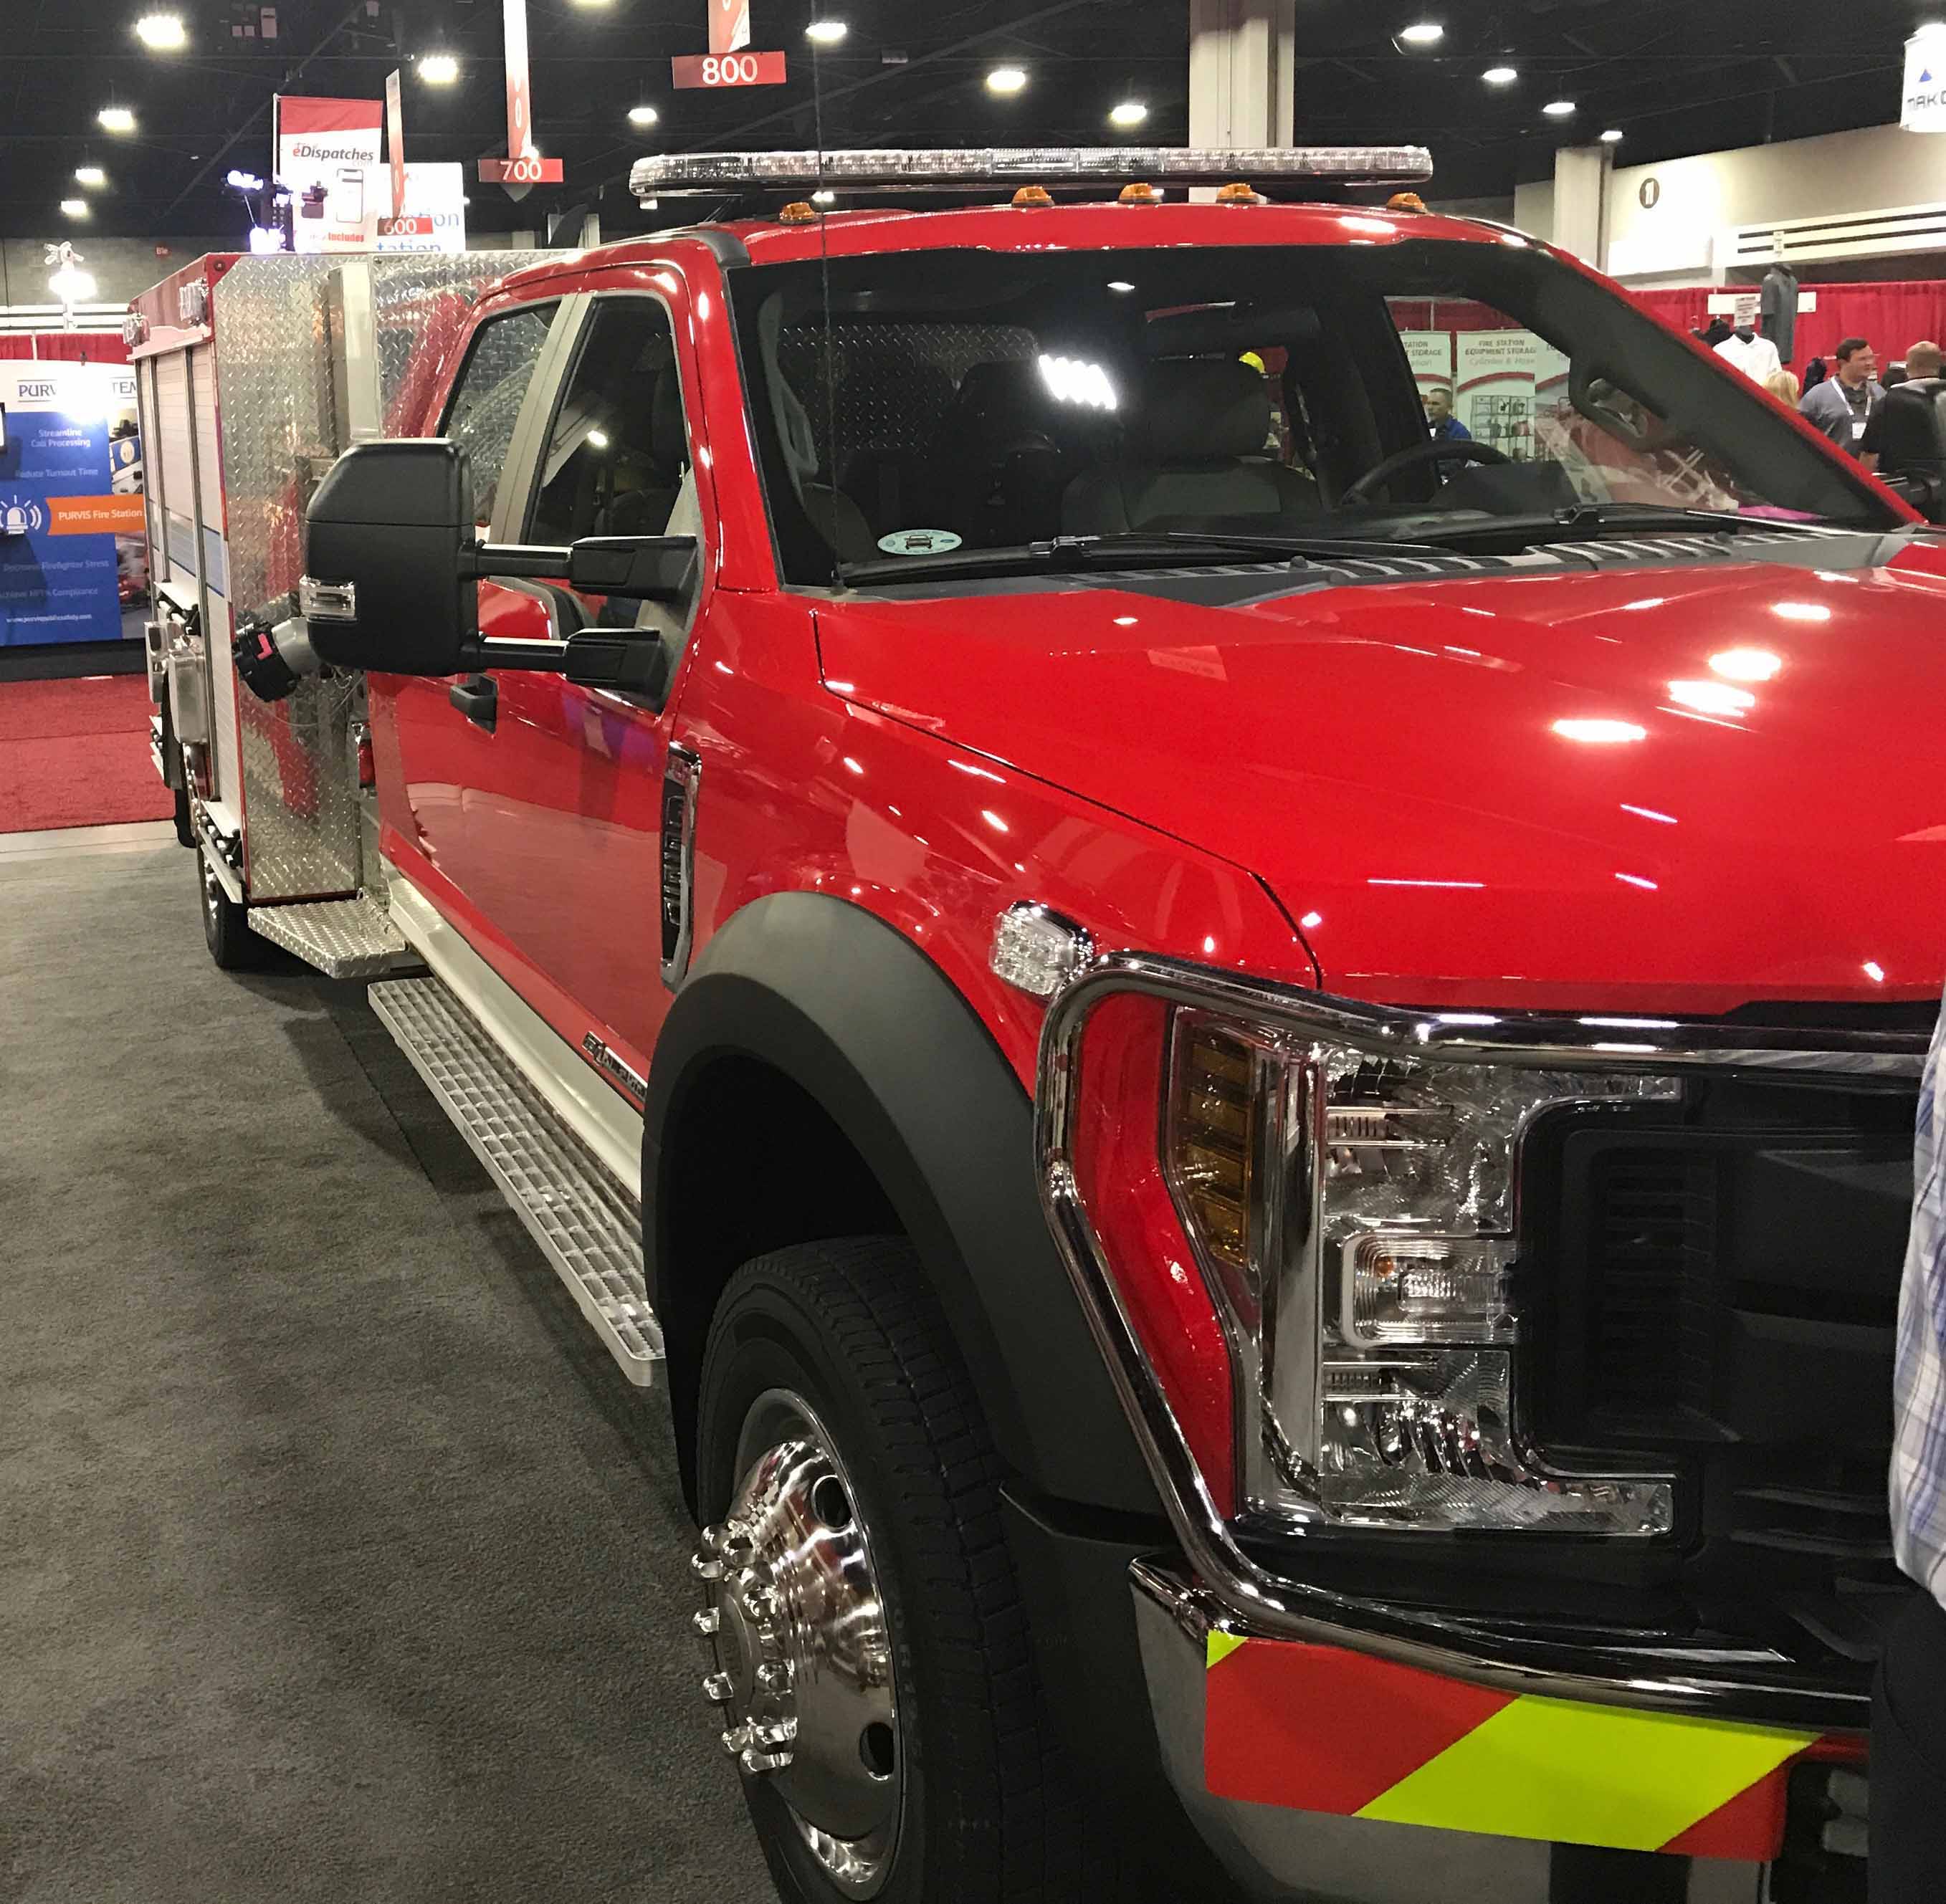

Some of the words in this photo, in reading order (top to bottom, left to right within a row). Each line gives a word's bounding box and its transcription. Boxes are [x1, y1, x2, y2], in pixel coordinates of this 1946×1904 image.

[702, 56, 758, 85] 800
[292, 145, 373, 161] eDispatches
[500, 160, 542, 181] 700
[383, 219, 417, 235] 600
[19, 384, 57, 397] PURV
[48, 439, 91, 448] Processing
[58, 510, 91, 521] PURVIS
[92, 510, 110, 519] Fire
[113, 509, 143, 518] Station
